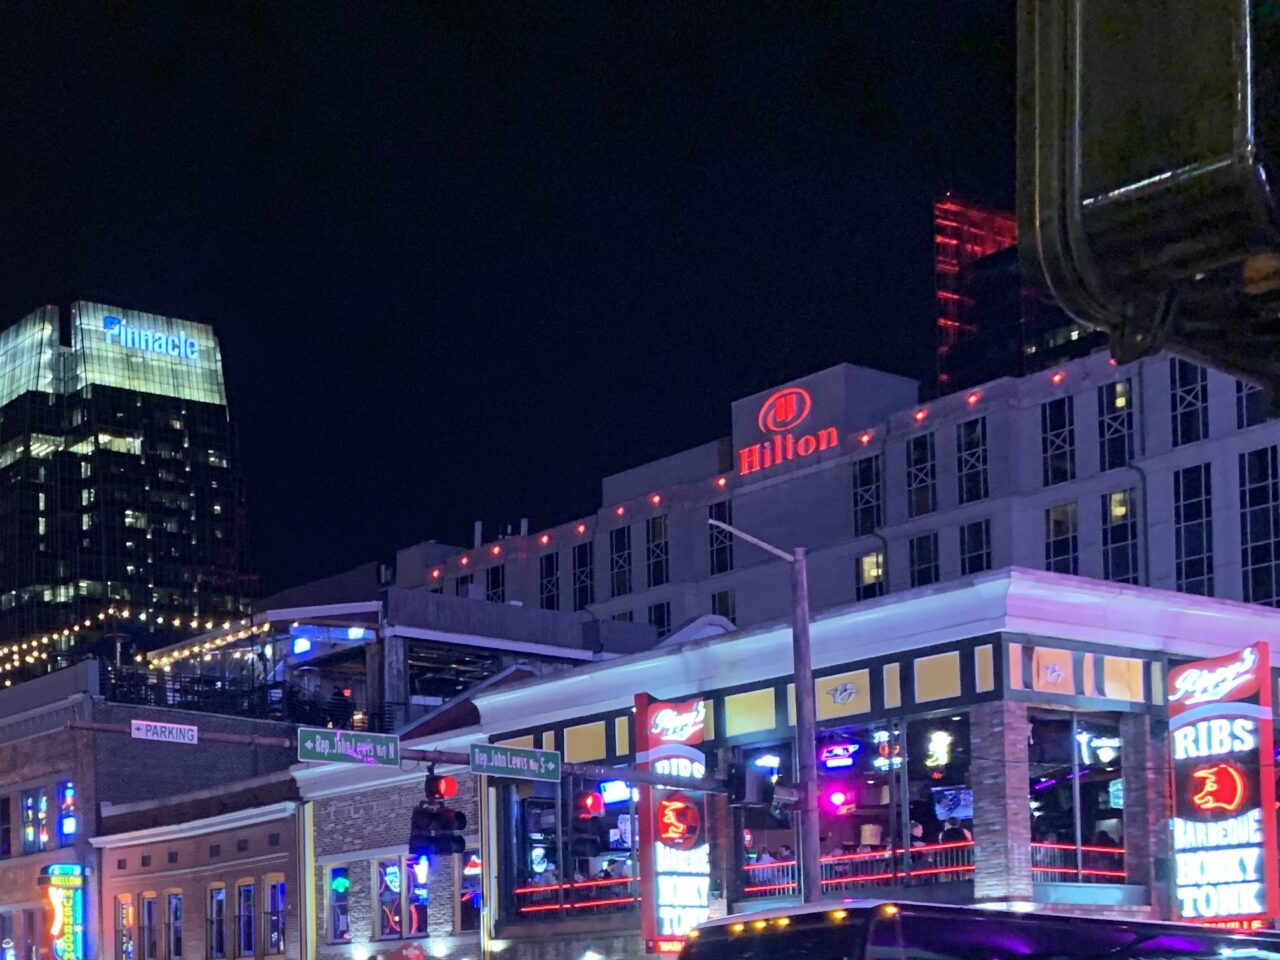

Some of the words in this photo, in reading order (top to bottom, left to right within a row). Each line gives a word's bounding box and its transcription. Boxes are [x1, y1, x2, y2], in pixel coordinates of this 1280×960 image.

[103, 315, 200, 360] Pinnacle
[739, 427, 839, 476] Hilton
[145, 724, 195, 741] PARKING
[388, 743, 395, 759] N
[1174, 718, 1255, 760] RIBS
[474, 748, 491, 769] Rep.
[491, 750, 507, 767] John
[507, 751, 528, 770] Lewis
[540, 757, 545, 773] S
[1173, 807, 1262, 850] BARBEQUE
[1175, 848, 1260, 885] HONKY
[1177, 882, 1263, 918] TONK
[62, 888, 75, 960] MUSHROOM
